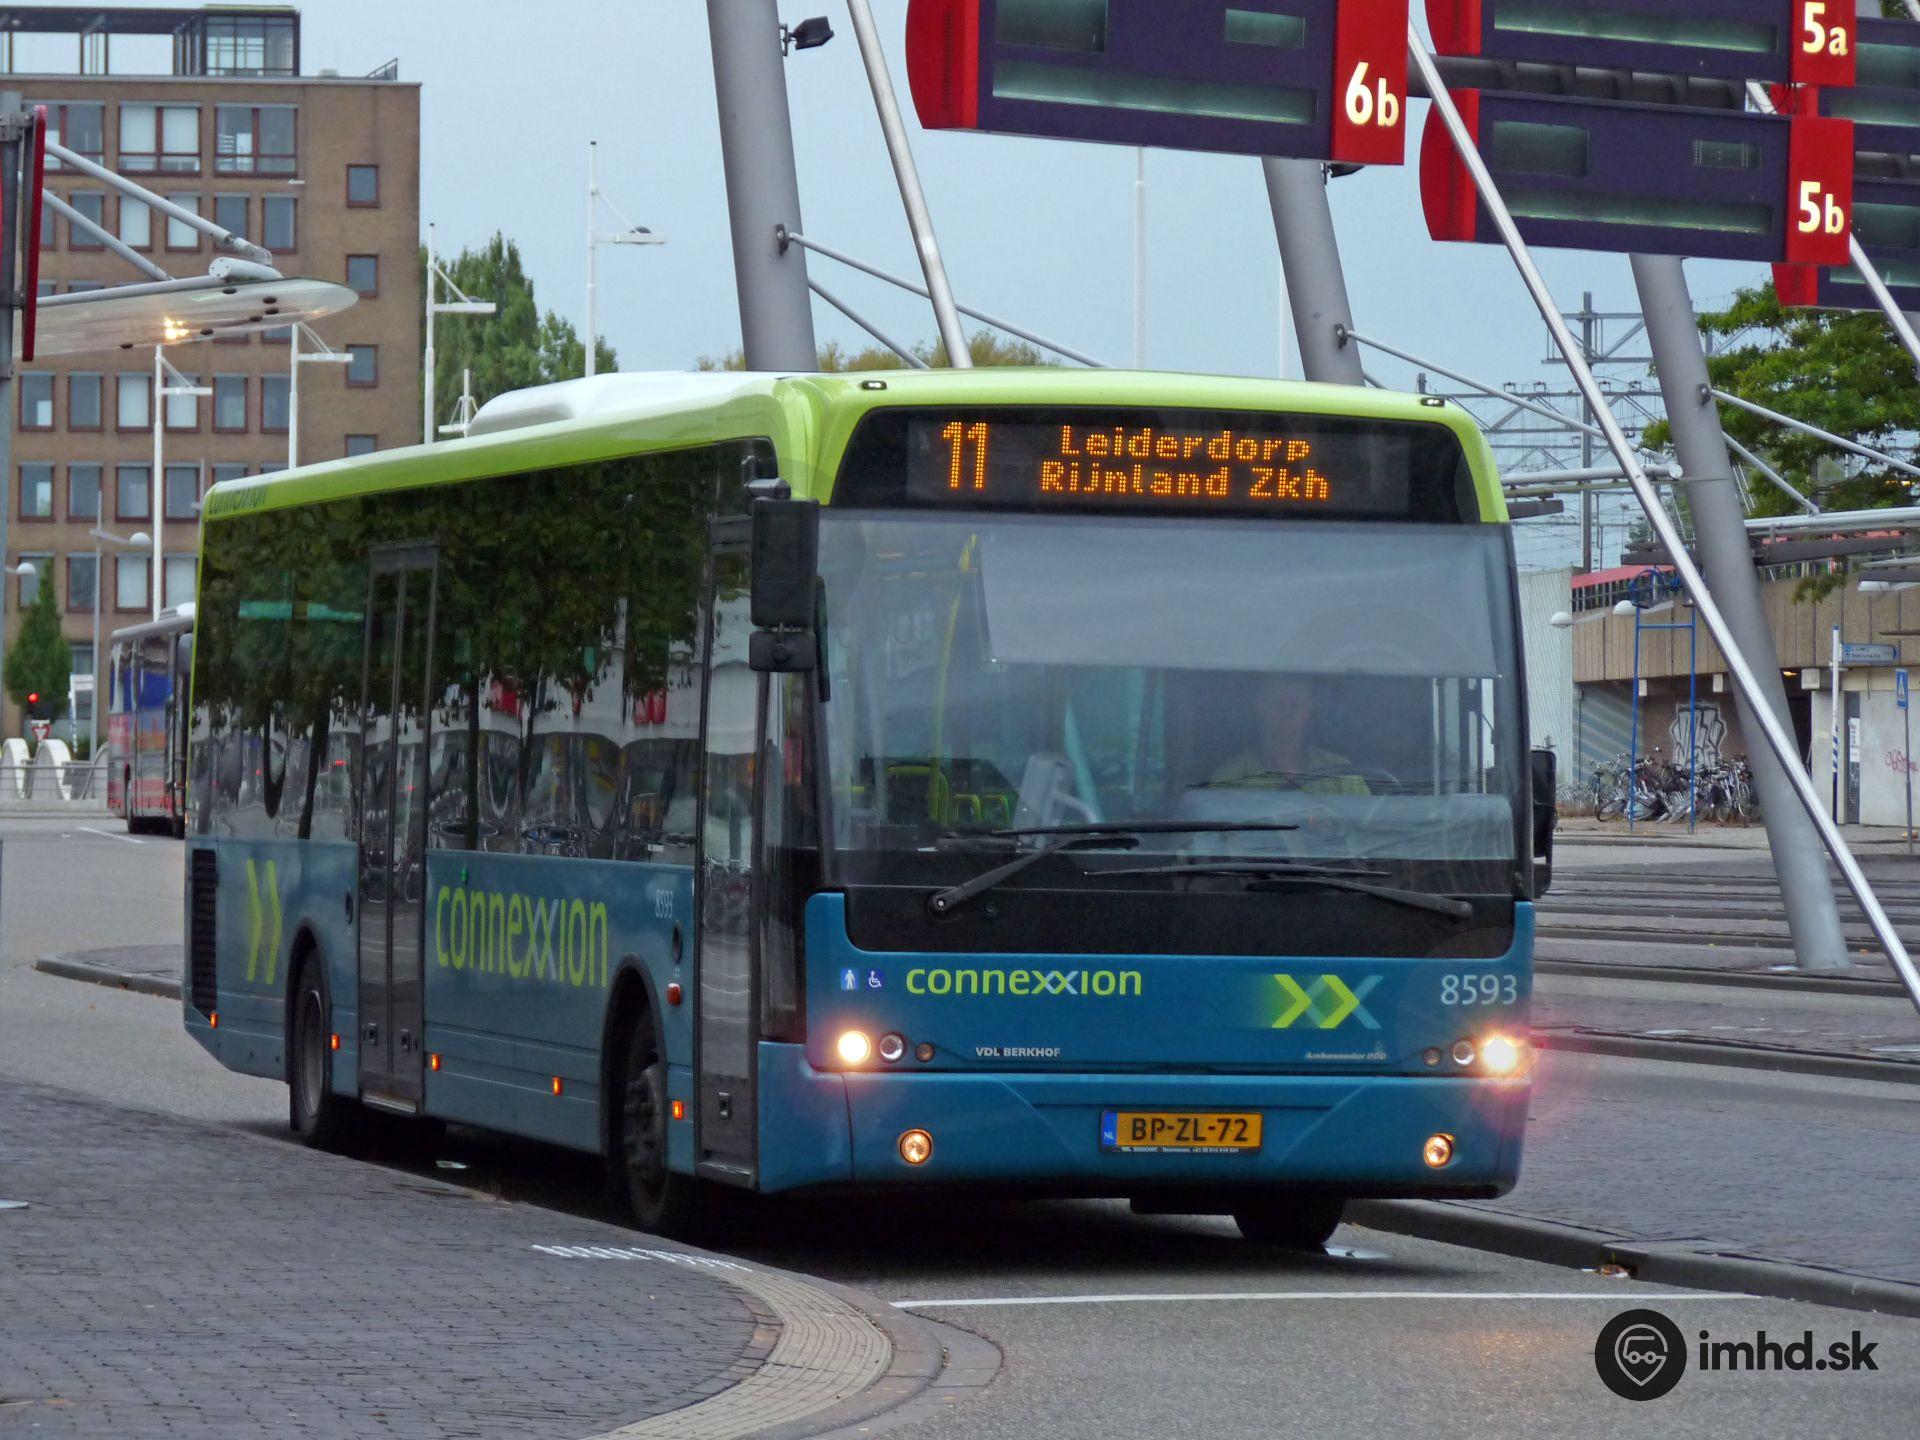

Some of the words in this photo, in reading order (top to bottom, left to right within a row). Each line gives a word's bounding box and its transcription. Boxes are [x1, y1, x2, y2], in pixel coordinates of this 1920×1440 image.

[1803, 2, 1848, 56] 5a
[1345, 61, 1399, 127] 6b
[1798, 181, 1845, 234] 5b
[942, 421, 988, 490] 11
[1061, 424, 1310, 463] Leiderdorp
[1040, 461, 1229, 497] Rijnland
[1250, 466, 1330, 500] Zkh
[655, 888, 674, 919] 8593
[436, 885, 608, 988] connexxion
[906, 968, 1142, 996] connexxion
[1440, 974, 1518, 1006] 8593
[975, 1046, 1000, 1057] VDL
[1003, 1047, 1061, 1057] BERKHOF
[1104, 1131, 1114, 1140] NL
[1131, 1117, 1248, 1142] BP-ZL-72
